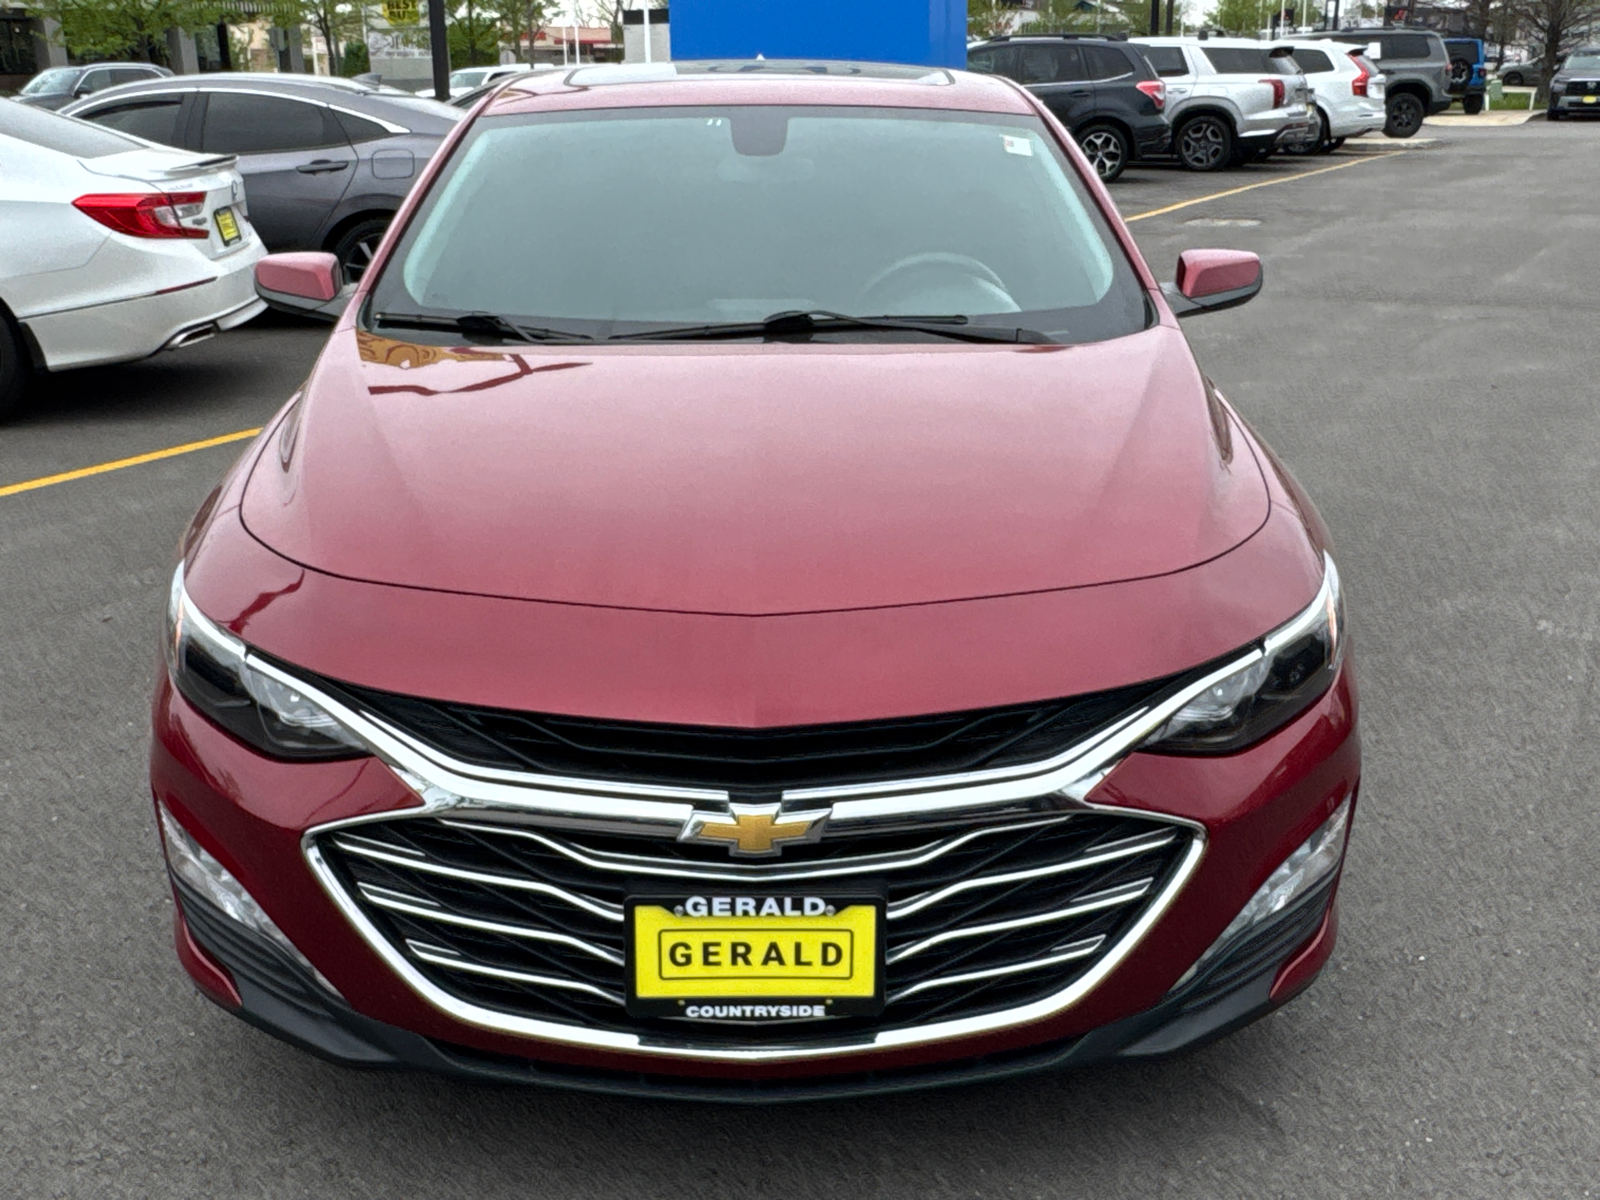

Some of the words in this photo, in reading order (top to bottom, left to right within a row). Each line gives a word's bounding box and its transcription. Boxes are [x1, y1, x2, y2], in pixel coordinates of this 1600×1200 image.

[685, 896, 826, 916] GERALD
[669, 942, 843, 967] GERALD
[685, 1005, 826, 1018] COUNTRYSIDE
